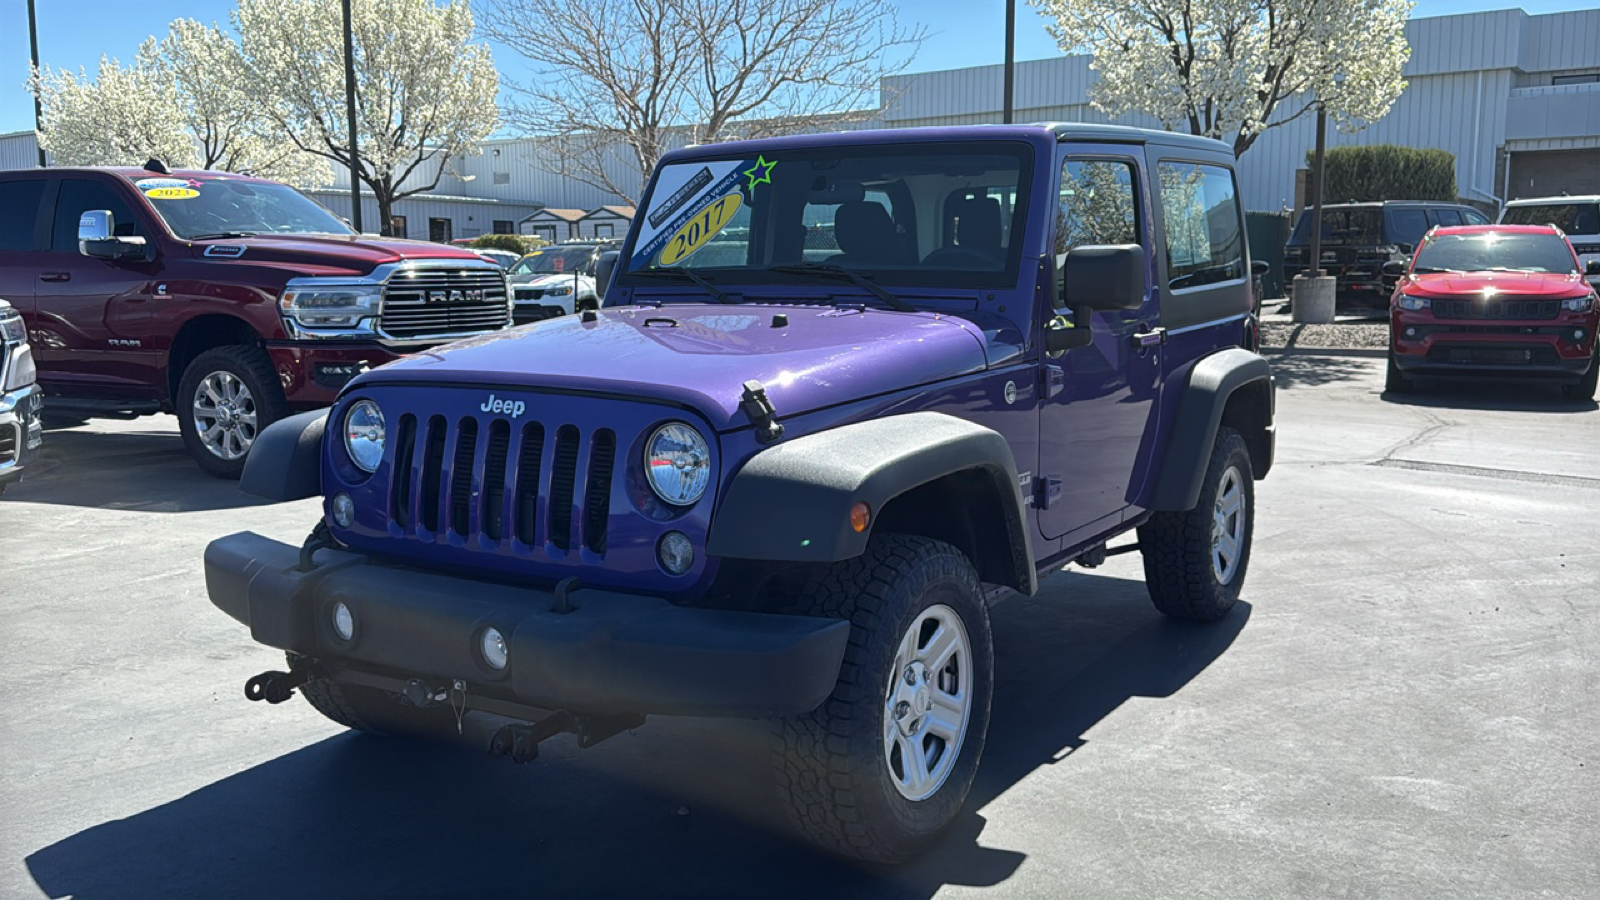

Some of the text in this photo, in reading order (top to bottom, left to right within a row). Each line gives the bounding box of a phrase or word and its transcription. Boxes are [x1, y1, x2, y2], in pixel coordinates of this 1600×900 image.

[157, 189, 191, 197] 2023
[642, 225, 674, 256] CERTIFIED
[673, 196, 711, 230] PRE-OWNED
[710, 173, 739, 197] VEHICLE
[674, 198, 727, 260] 2017
[429, 289, 481, 302] RAM
[108, 339, 141, 347] RAM
[480, 394, 526, 419] Jeep
